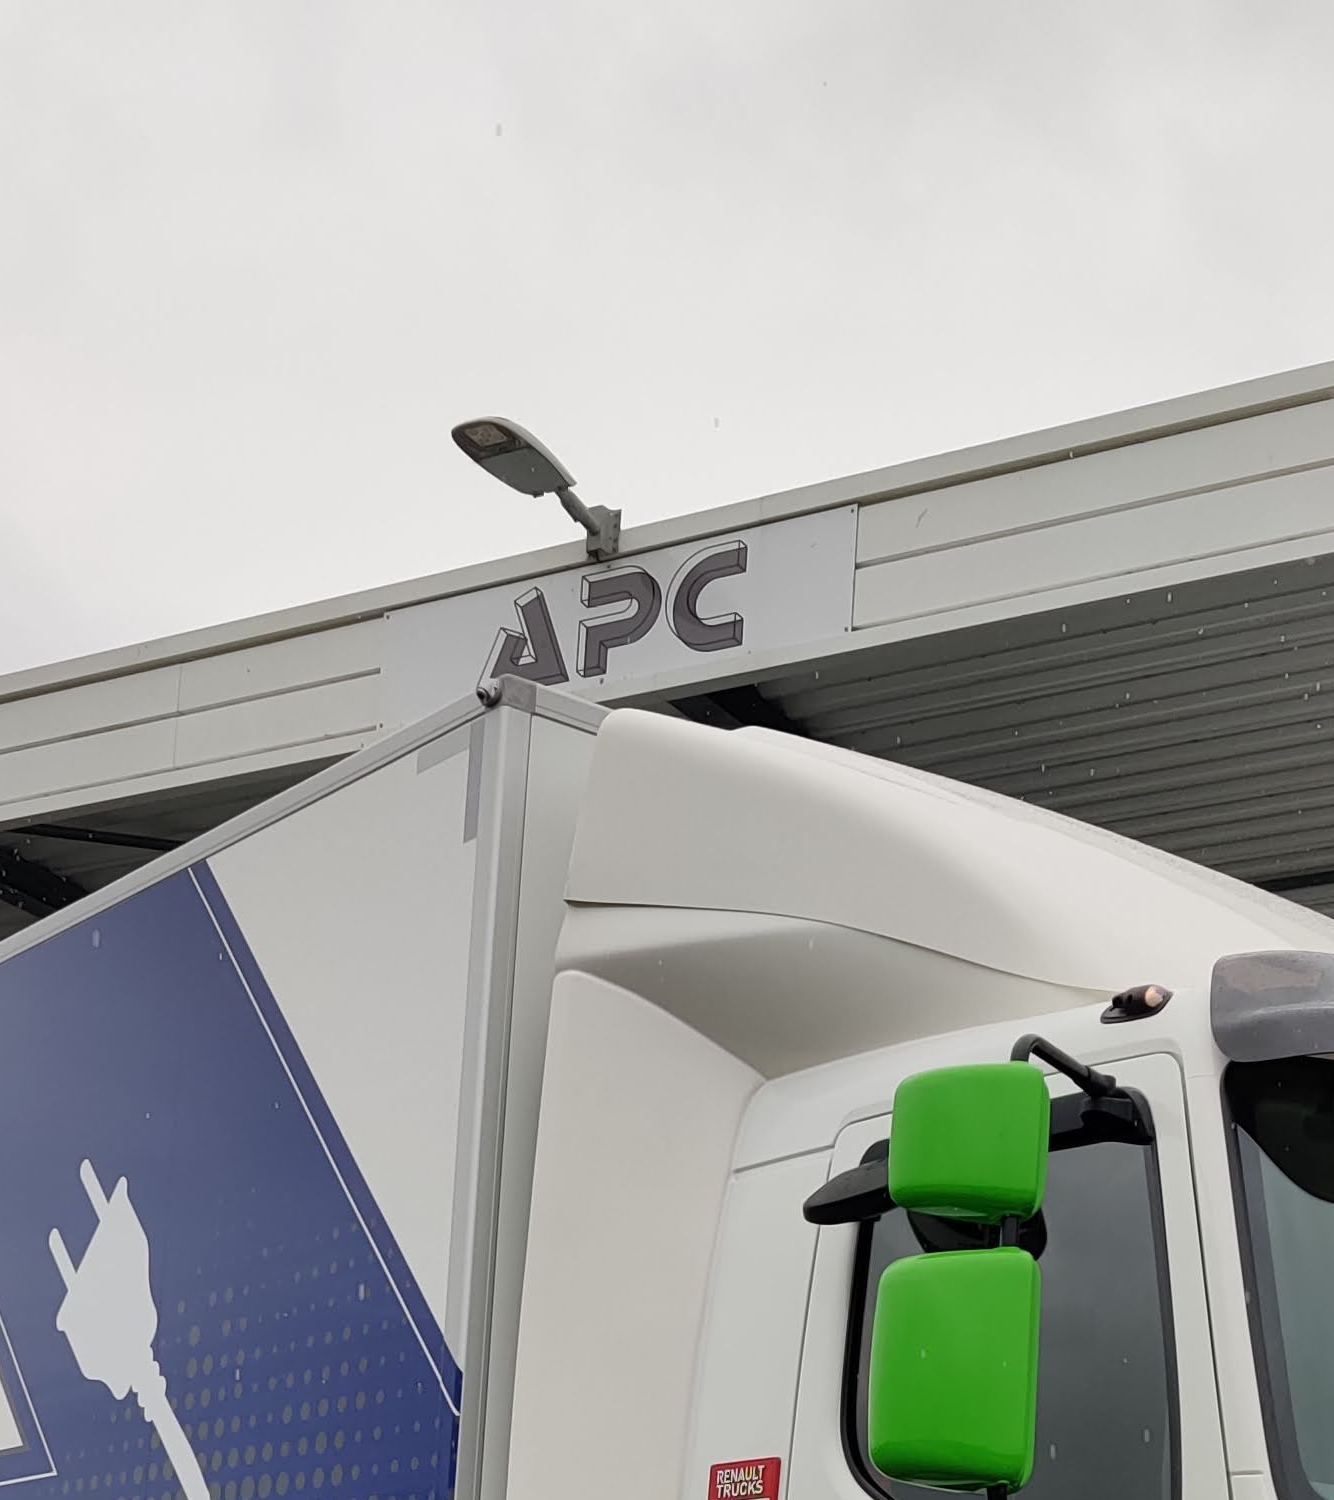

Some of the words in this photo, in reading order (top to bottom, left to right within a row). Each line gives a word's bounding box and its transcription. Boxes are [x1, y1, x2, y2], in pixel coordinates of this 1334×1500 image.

[477, 540, 748, 688] APC
[716, 1465, 765, 1485] RENAULT
[716, 1480, 764, 1499] TRUCKS
